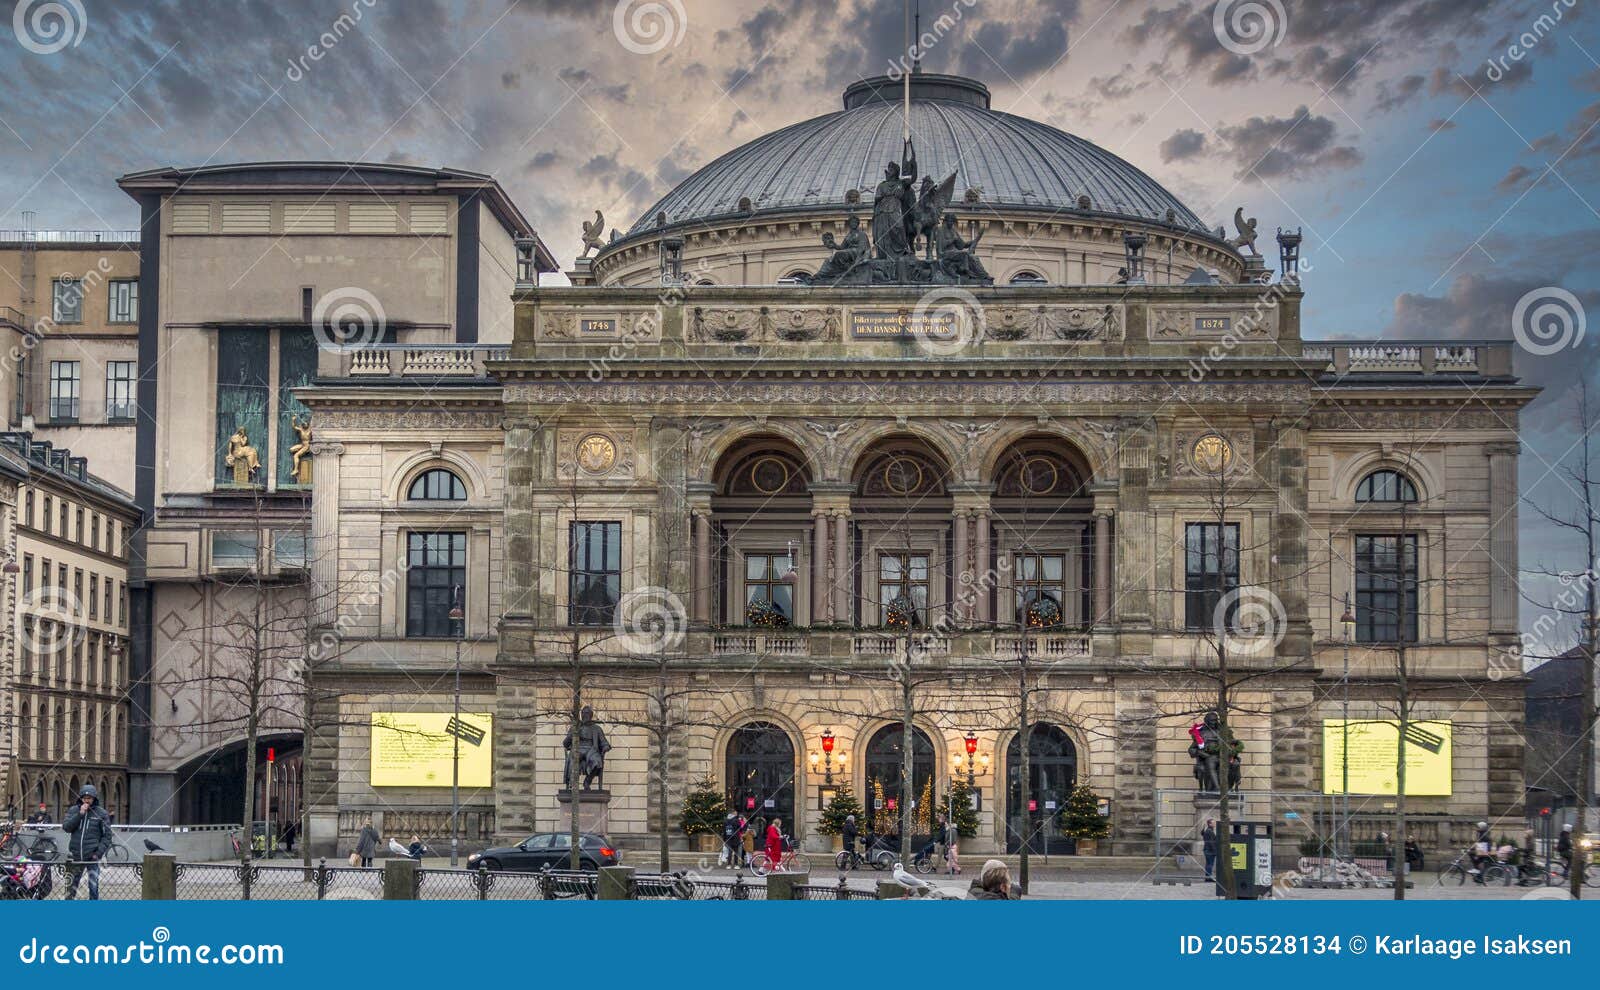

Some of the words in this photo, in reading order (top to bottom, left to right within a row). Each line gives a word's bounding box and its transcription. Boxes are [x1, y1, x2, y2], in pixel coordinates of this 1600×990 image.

[588, 321, 609, 330] 1748
[1202, 319, 1225, 329] 1874
[856, 325, 872, 334] DEN
